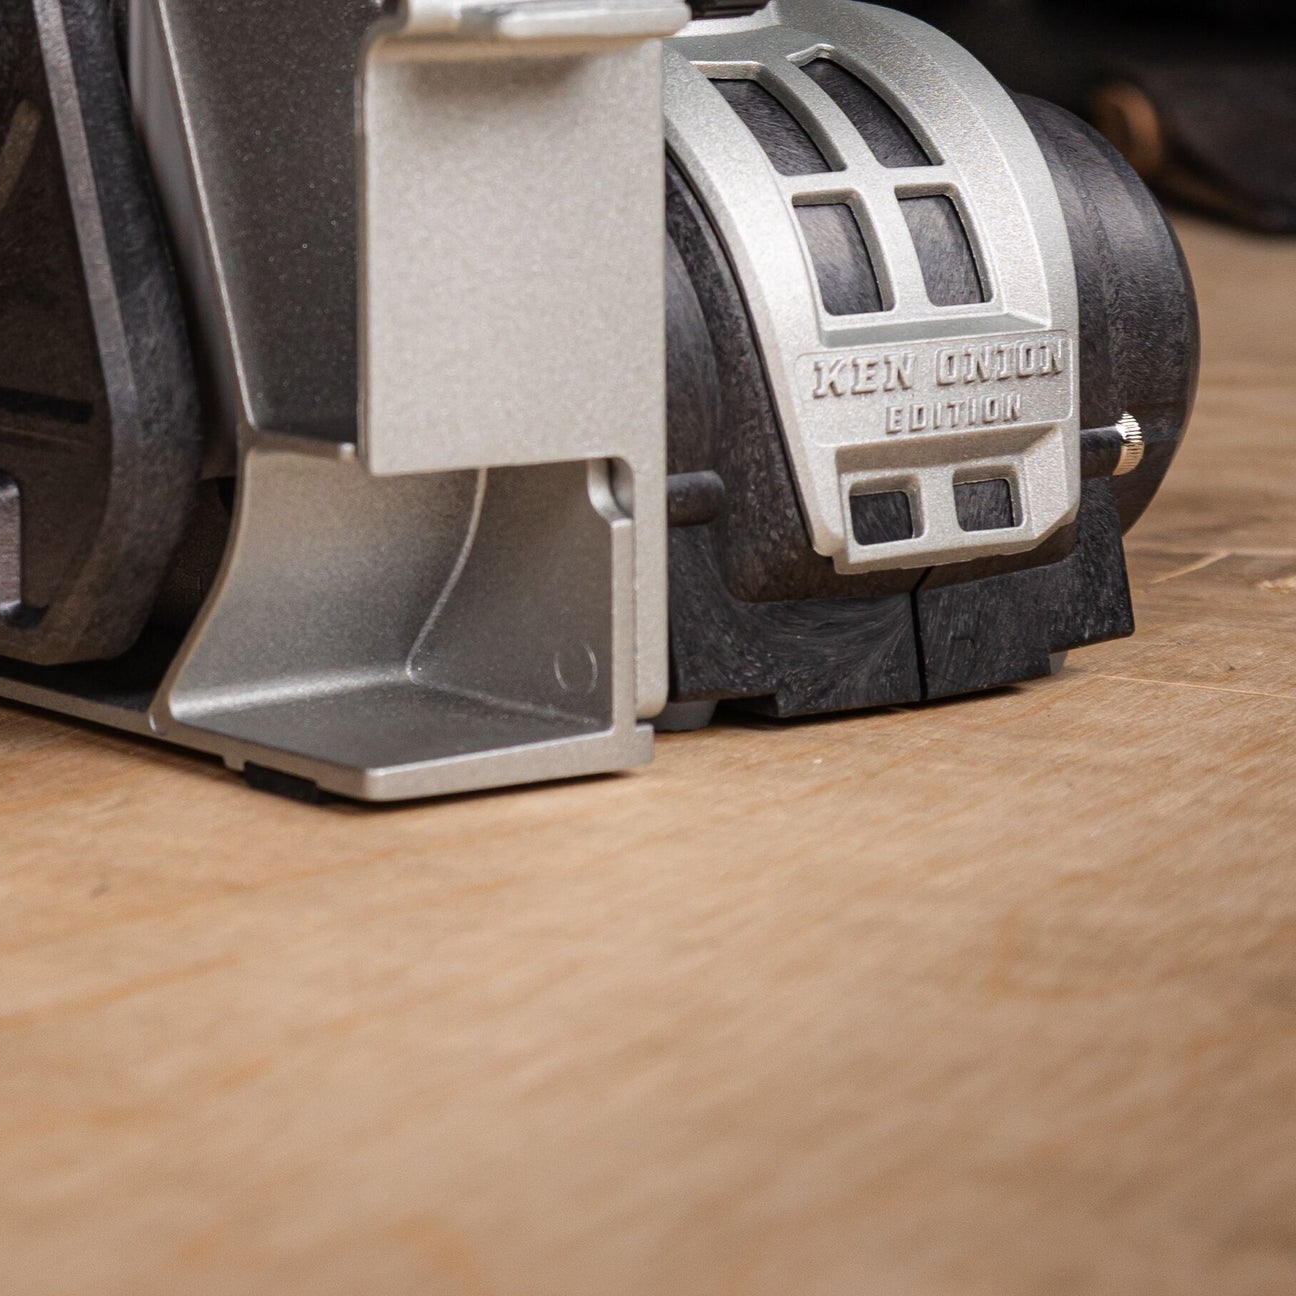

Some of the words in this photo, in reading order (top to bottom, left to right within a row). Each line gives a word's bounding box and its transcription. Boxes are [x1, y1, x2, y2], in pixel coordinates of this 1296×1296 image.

[813, 353, 916, 399] KEN
[936, 338, 1063, 387] ONION
[886, 394, 1021, 434] EDITION
